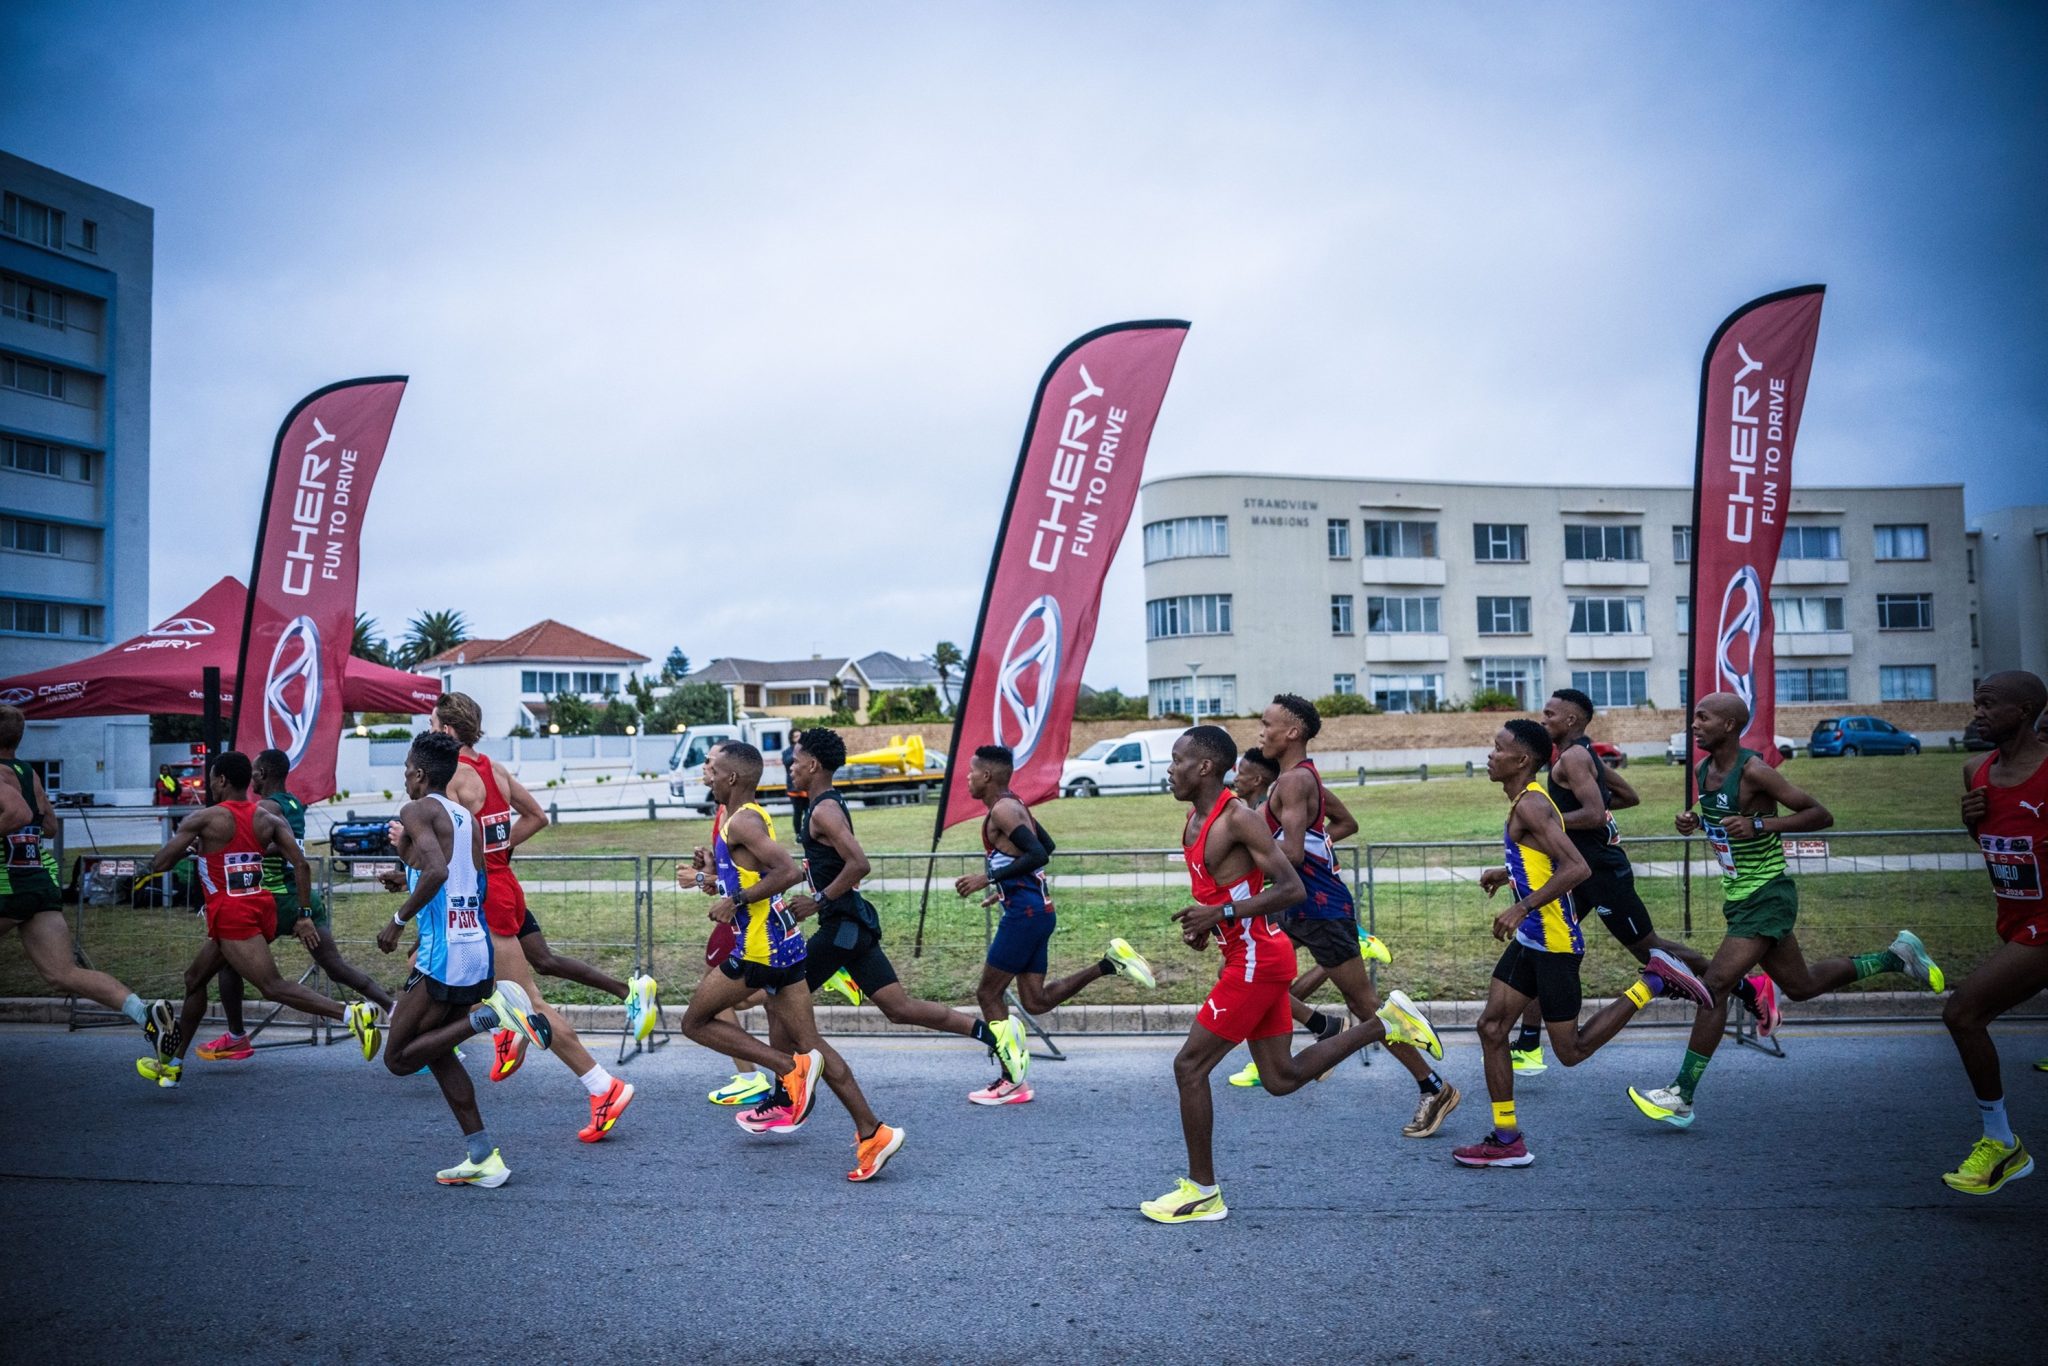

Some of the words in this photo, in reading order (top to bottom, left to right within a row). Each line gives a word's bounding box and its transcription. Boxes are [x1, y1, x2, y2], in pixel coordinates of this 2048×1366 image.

[1768, 378, 1786, 442] DRIVE
[1094, 405, 1128, 474] DRIVE
[1727, 342, 1763, 543] CHERY
[1029, 363, 1105, 573] CHERY
[1764, 446, 1781, 475] TO
[333, 448, 358, 507] DRIVE
[1084, 477, 1107, 506] TO
[282, 417, 337, 596] CHERY
[1243, 498, 1319, 511] STRANDVIEW
[1762, 481, 1778, 525] FUN
[328, 510, 347, 536] TO
[1071, 512, 1099, 558] FUN
[1251, 516, 1310, 528] MANSIONS
[322, 541, 344, 580] FUN
[123, 639, 202, 652] CHERY
[38, 680, 88, 697] CHERY
[495, 823, 506, 840] 66
[25, 844, 36, 859] 88
[1991, 863, 2019, 881] TUMELO
